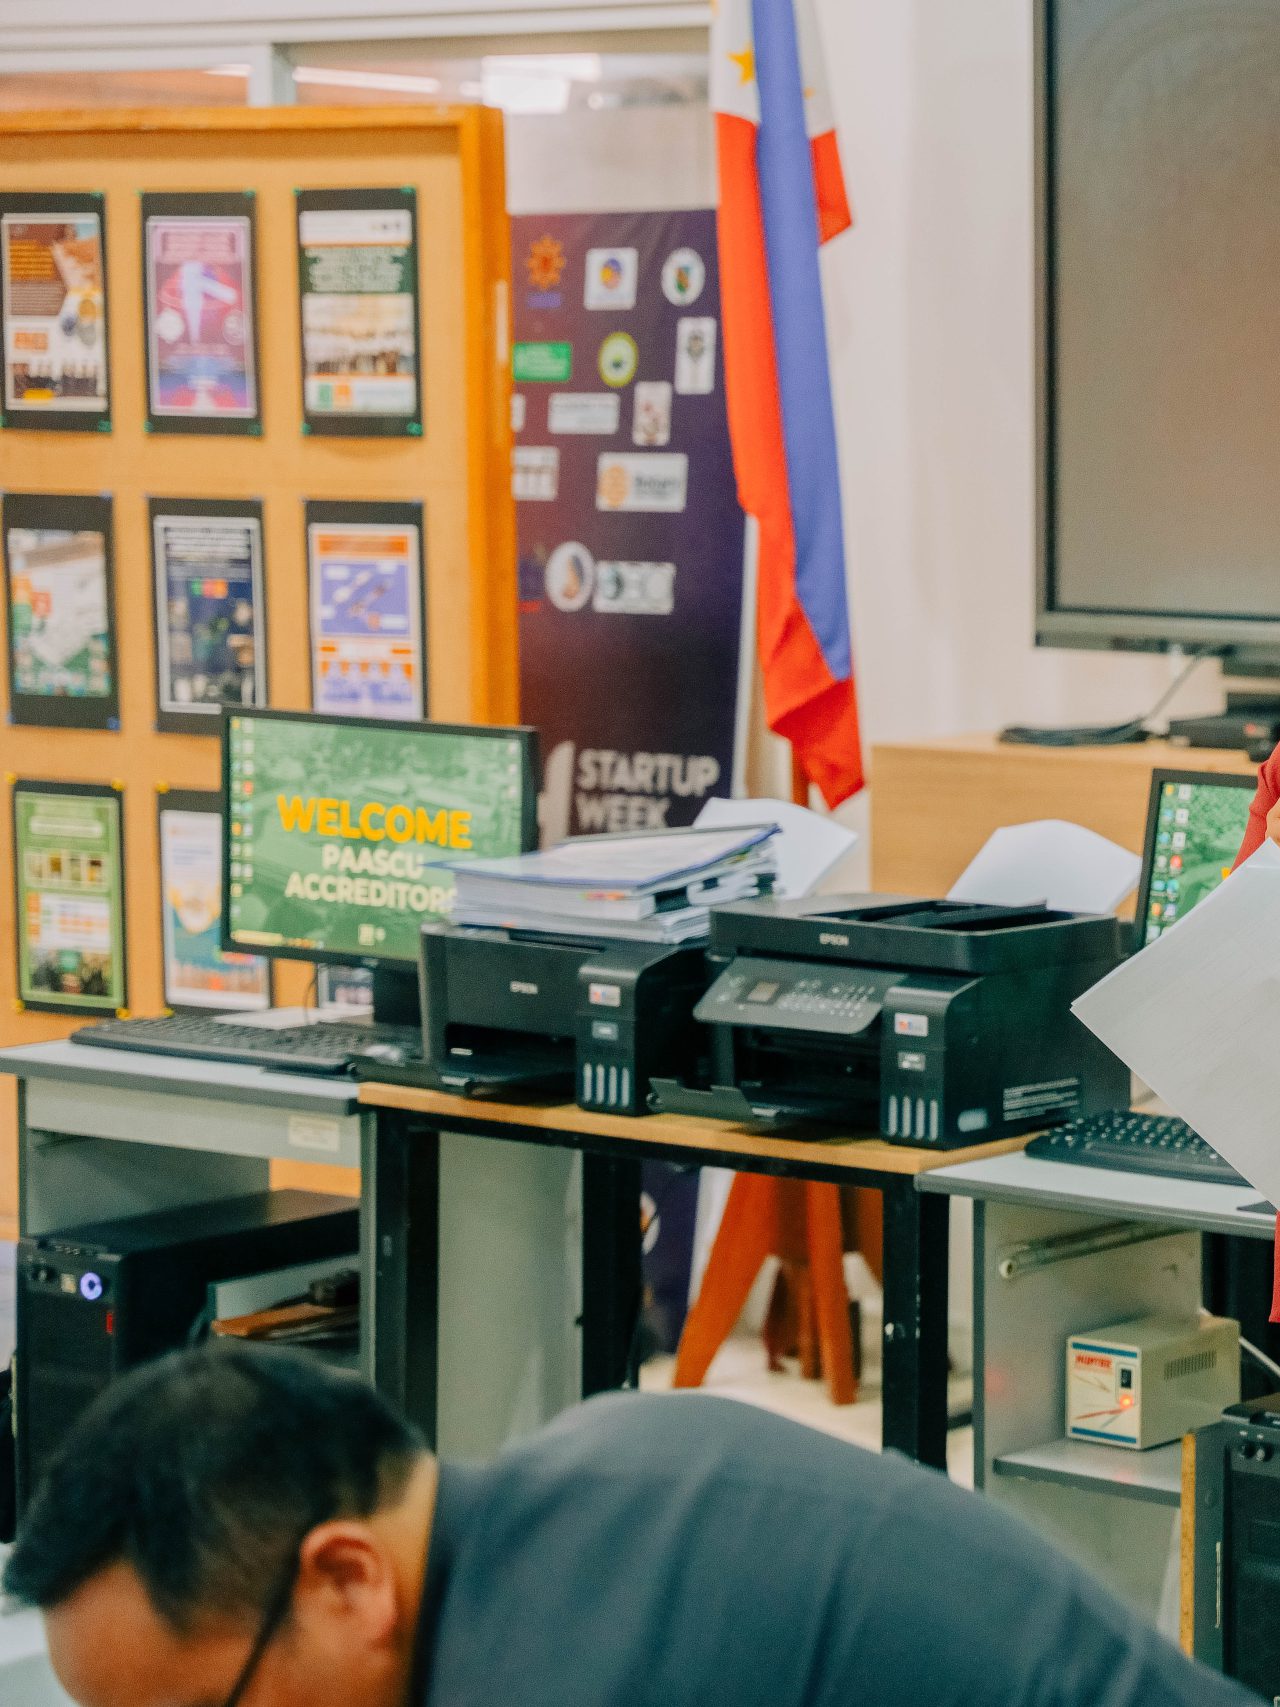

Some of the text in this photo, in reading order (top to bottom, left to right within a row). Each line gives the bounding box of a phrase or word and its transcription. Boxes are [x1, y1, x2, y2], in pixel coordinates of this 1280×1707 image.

[577, 748, 721, 798] STARTUP
[276, 794, 473, 850] WELCOME
[576, 791, 671, 834] WEEK
[321, 843, 425, 880] PAASCU
